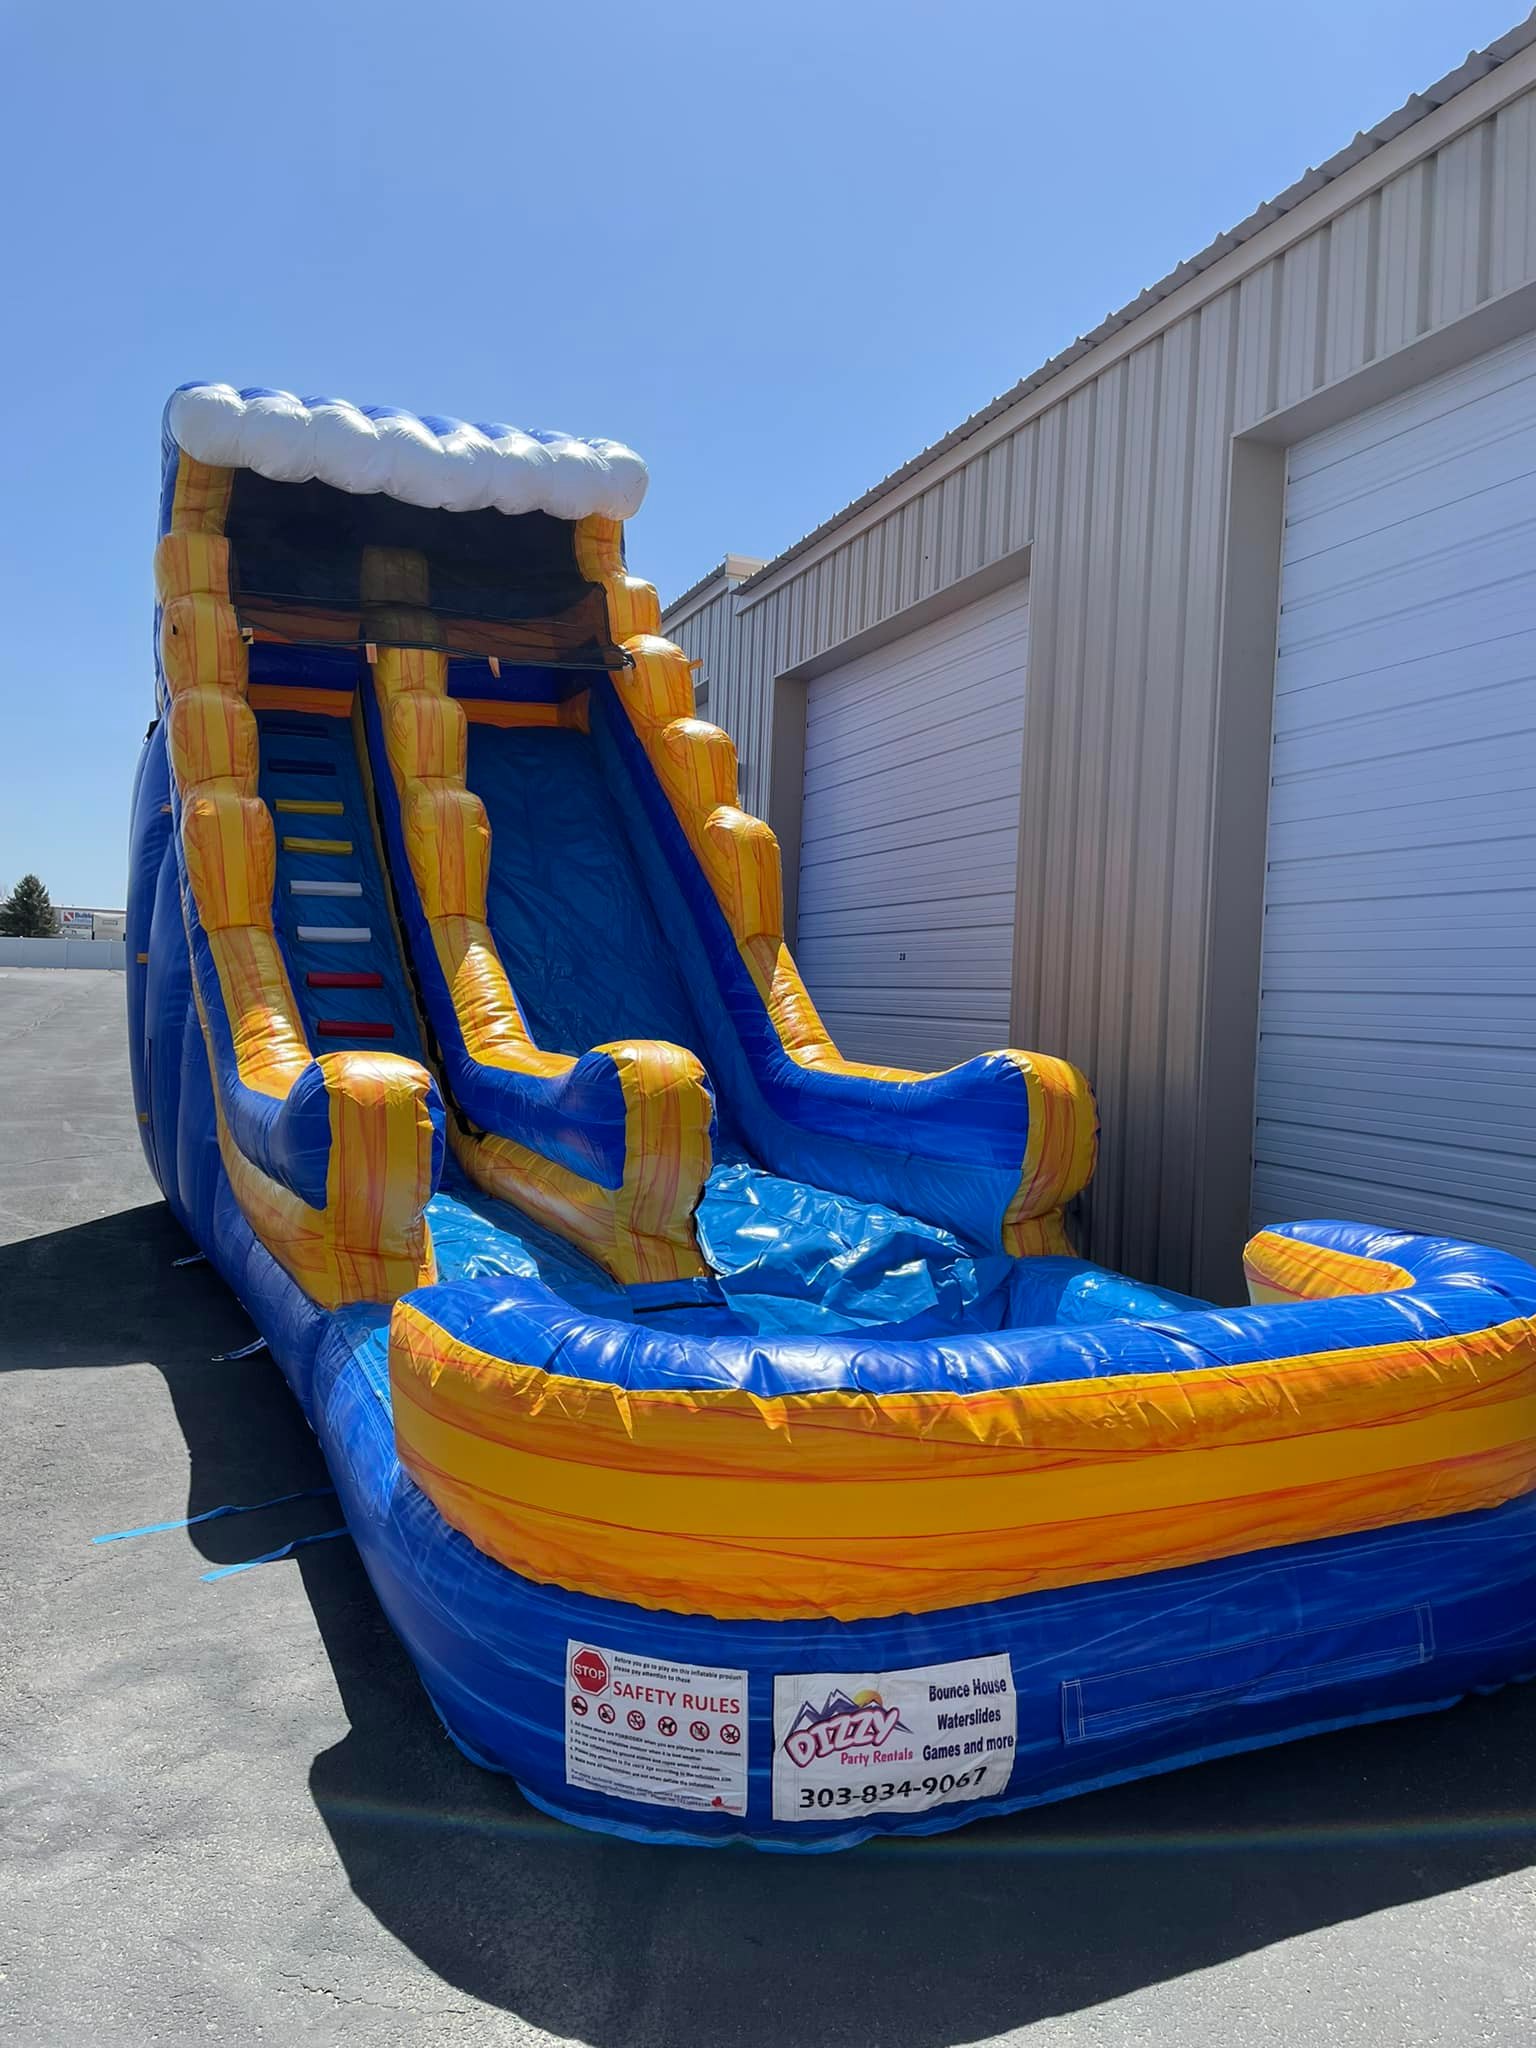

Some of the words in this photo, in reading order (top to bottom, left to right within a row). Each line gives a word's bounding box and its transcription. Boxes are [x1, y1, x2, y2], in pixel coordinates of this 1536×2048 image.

[574, 1663, 606, 1680] STOP
[613, 1665, 630, 1673] please
[632, 1668, 641, 1676] pay
[642, 1670, 668, 1680] attention
[675, 1675, 691, 1684] these
[614, 1655, 631, 1665] Before
[633, 1659, 642, 1667] you
[658, 1664, 670, 1673] play
[680, 1667, 690, 1675] this
[691, 1669, 718, 1679] inflatable
[613, 1680, 677, 1707] SAFETY
[682, 1693, 741, 1715] RULES
[928, 1682, 970, 1703] Bounce
[972, 1677, 1008, 1697] House
[936, 1706, 1002, 1731] Waterslides
[784, 1706, 900, 1769] DIZZY
[922, 1741, 961, 1762] Games
[963, 1737, 985, 1756] and
[986, 1733, 1014, 1751] more
[840, 1750, 869, 1768] Party
[873, 1746, 913, 1765] Rentals
[799, 1765, 988, 1809] 303-834-9067
